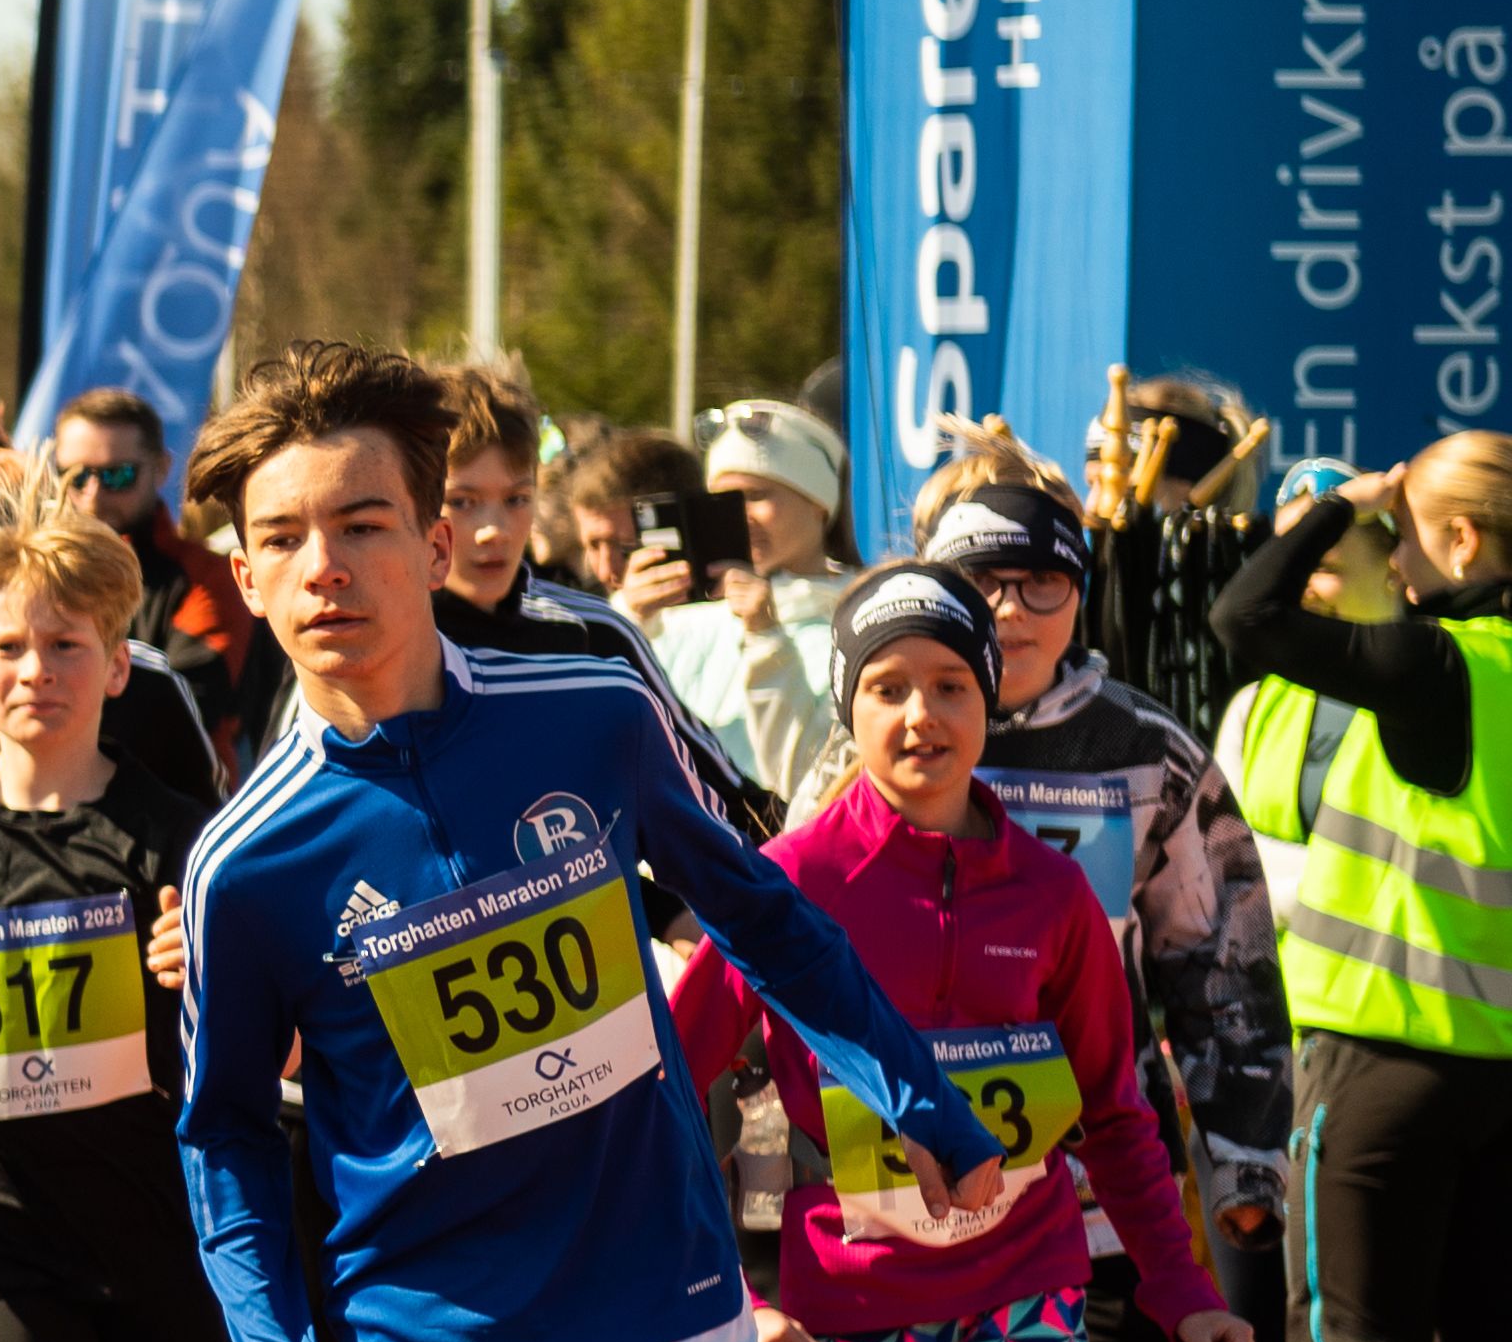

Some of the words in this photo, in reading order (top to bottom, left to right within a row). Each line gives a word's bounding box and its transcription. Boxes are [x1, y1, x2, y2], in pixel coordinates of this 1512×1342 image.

[1420, 25, 1512, 156] på
[1270, 344, 1359, 475] En
[1029, 784, 1098, 806] Maraton
[10, 912, 79, 941] Maraton
[84, 905, 125, 929] 2023
[337, 897, 402, 938] adidas
[365, 906, 477, 959] Torghatten
[479, 874, 563, 918] Maraton
[565, 849, 609, 883] 2023
[432, 916, 600, 1055] 530
[933, 1039, 1005, 1063] Maraton
[1009, 1031, 1052, 1054] 2023
[502, 1059, 615, 1117] TORGHATTEN
[548, 1093, 593, 1119] AQUA
